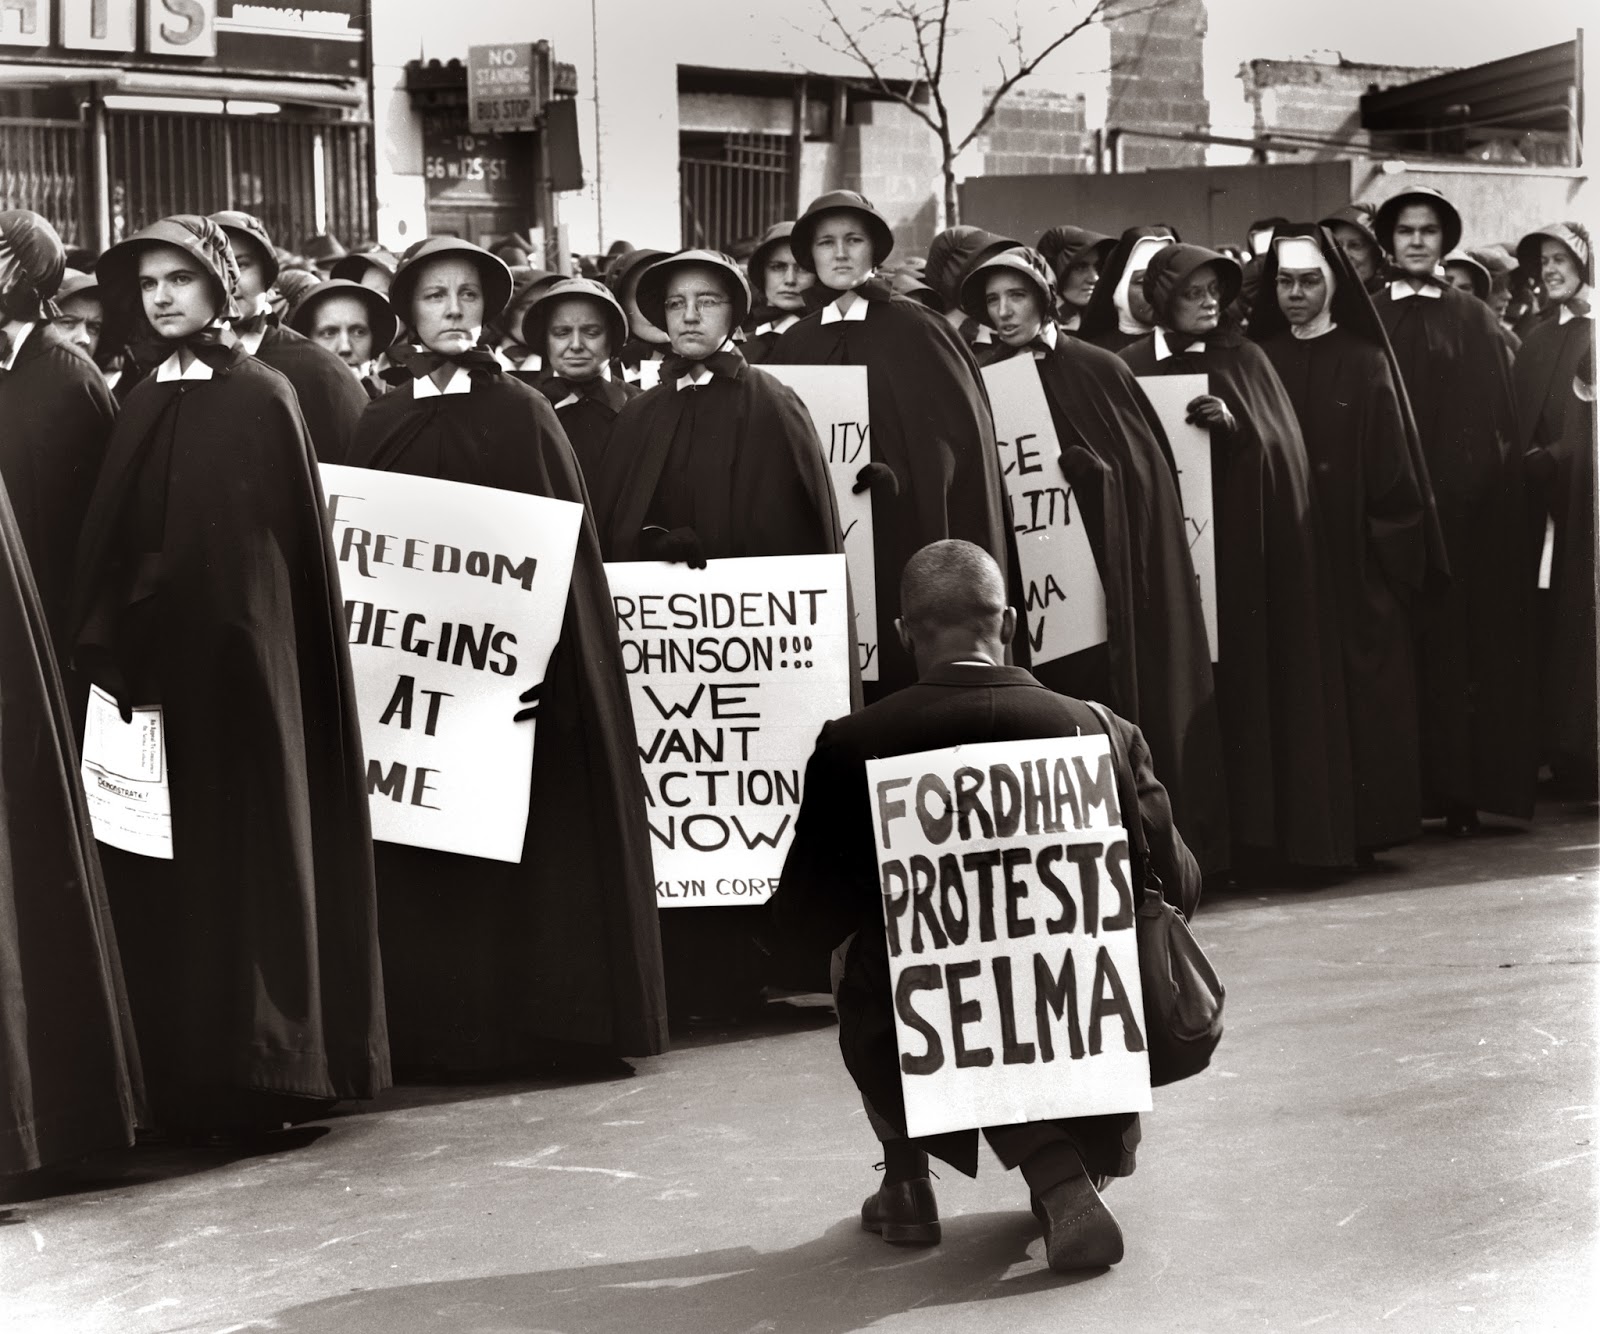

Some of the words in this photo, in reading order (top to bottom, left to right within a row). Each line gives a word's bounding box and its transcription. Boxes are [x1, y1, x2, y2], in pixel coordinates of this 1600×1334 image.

[488, 48, 517, 66] NO
[477, 101, 499, 120] BUS
[503, 99, 530, 119] STOP
[829, 421, 869, 464] ITY
[328, 494, 538, 592] FREEDOM
[612, 588, 828, 632] RESIDENT
[343, 599, 518, 677] BEGINS
[620, 636, 814, 675] OHNSON!!!
[378, 673, 456, 737] AT
[642, 682, 761, 721] WE
[367, 759, 442, 811] ME
[876, 752, 1123, 850] FORDHAM
[648, 813, 792, 852] NOW
[656, 878, 706, 898] KLYN
[881, 839, 1136, 958] PROTESTS
[894, 944, 1149, 1076] SELMA
